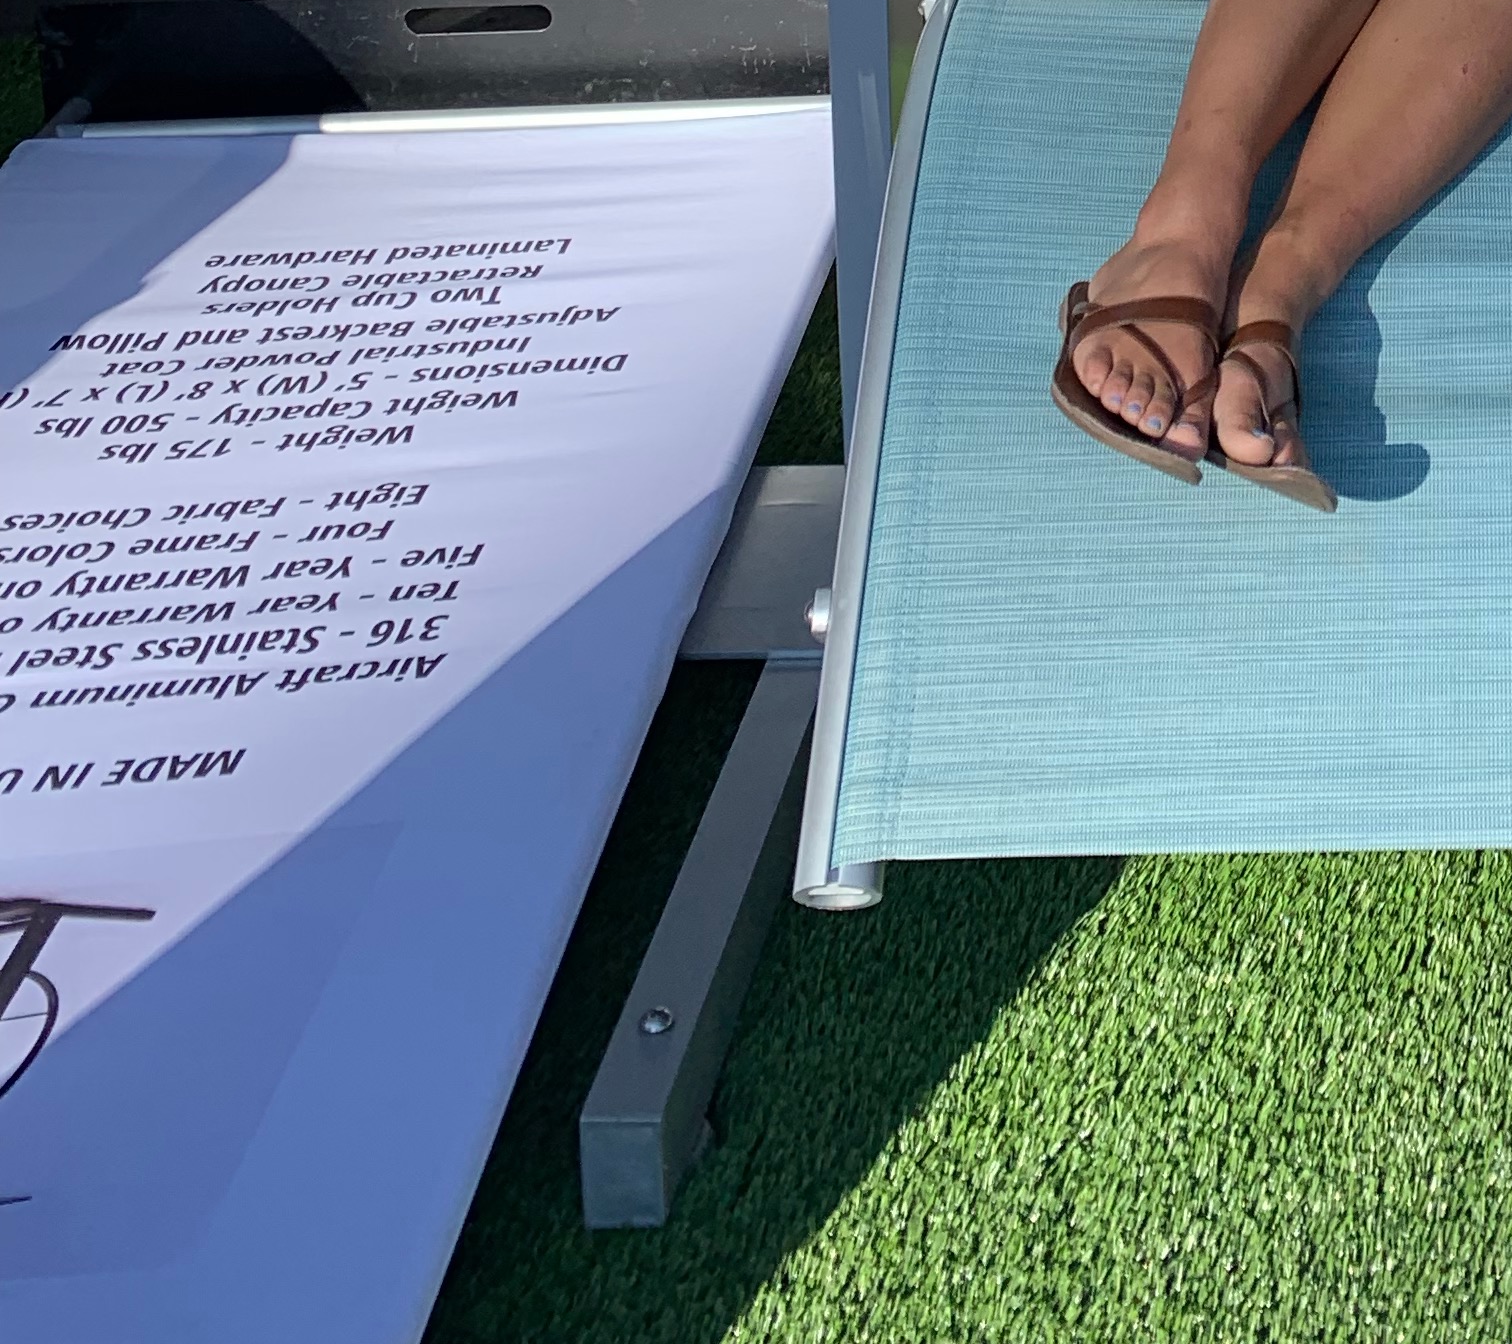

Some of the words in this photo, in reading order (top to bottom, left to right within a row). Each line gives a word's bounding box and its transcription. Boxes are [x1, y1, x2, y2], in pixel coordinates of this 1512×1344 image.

[204, 248, 379, 270] Hardware
[383, 238, 573, 266] Laminated
[196, 273, 331, 295] Canopy
[341, 264, 545, 291] Retractable
[200, 295, 342, 318] Holders
[350, 289, 418, 311] Cup
[429, 285, 503, 306] Two
[255, 320, 416, 346] Backrest
[424, 304, 622, 336] Adjustable
[48, 331, 169, 355] Pillow
[171, 328, 250, 353] and
[346, 336, 533, 366] Industrial
[98, 359, 187, 379] Coat
[192, 349, 343, 374] Powder
[408, 353, 629, 384] Dimensions
[79, 386, 110, 403] x
[115, 379, 170, 405] (L)
[220, 378, 251, 395] x
[256, 370, 329, 397] (W)
[207, 396, 373, 428] Capacity
[382, 388, 519, 417] Weight
[33, 416, 95, 439] lbs
[99, 412, 176, 436] 500
[163, 437, 232, 461] 175
[274, 424, 415, 453] Weight
[96, 441, 159, 465] lbs
[323, 481, 430, 513] Eight
[0, 507, 152, 534] Choices
[160, 496, 288, 526] Fabric
[127, 530, 261, 556] Frame
[296, 519, 396, 544] Four
[260, 555, 354, 582] Year
[399, 543, 486, 570] Five
[49, 564, 252, 599] Warranty
[387, 579, 461, 603] Ten
[30, 600, 237, 634] Warranty
[245, 591, 341, 616] Year
[365, 614, 450, 649] 316
[130, 625, 328, 666] Stainless
[4, 642, 125, 677] Steel
[274, 652, 449, 694] Aircraft
[29, 670, 270, 709] Aluminum
[31, 761, 96, 793] IN
[100, 747, 247, 787] MADE
